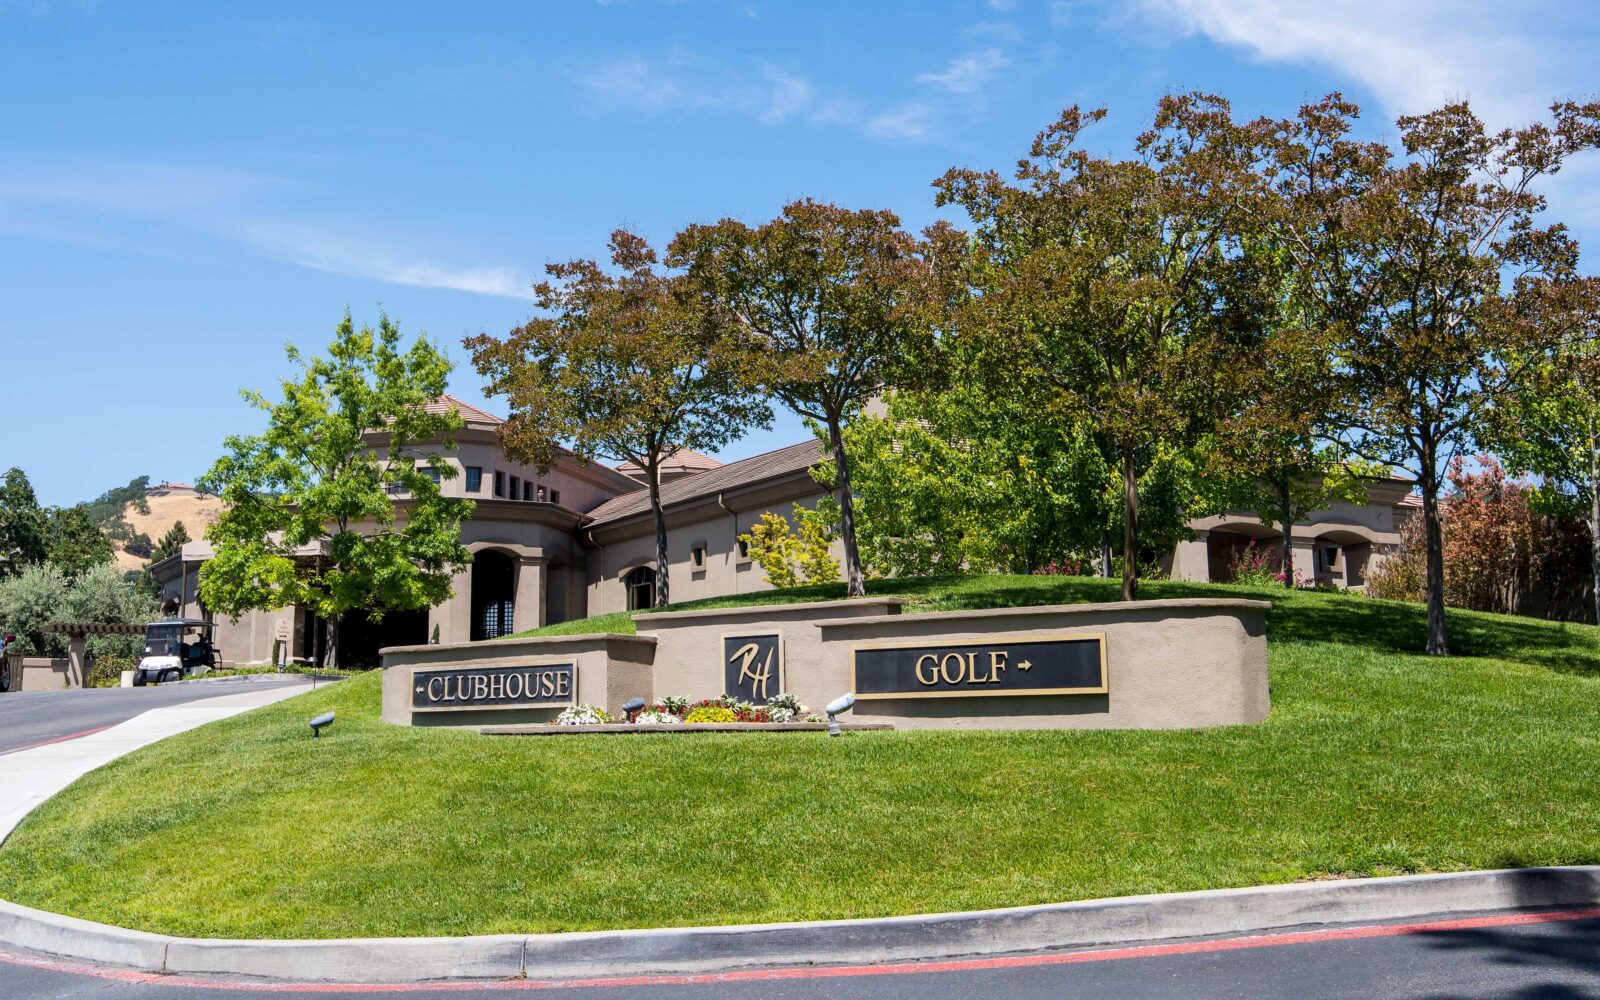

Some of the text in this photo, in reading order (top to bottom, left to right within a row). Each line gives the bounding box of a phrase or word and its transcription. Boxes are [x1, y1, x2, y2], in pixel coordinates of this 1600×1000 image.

[427, 670, 570, 702] CLUBHOUSE
[729, 643, 774, 700] RH
[915, 651, 1008, 686] GOLF
